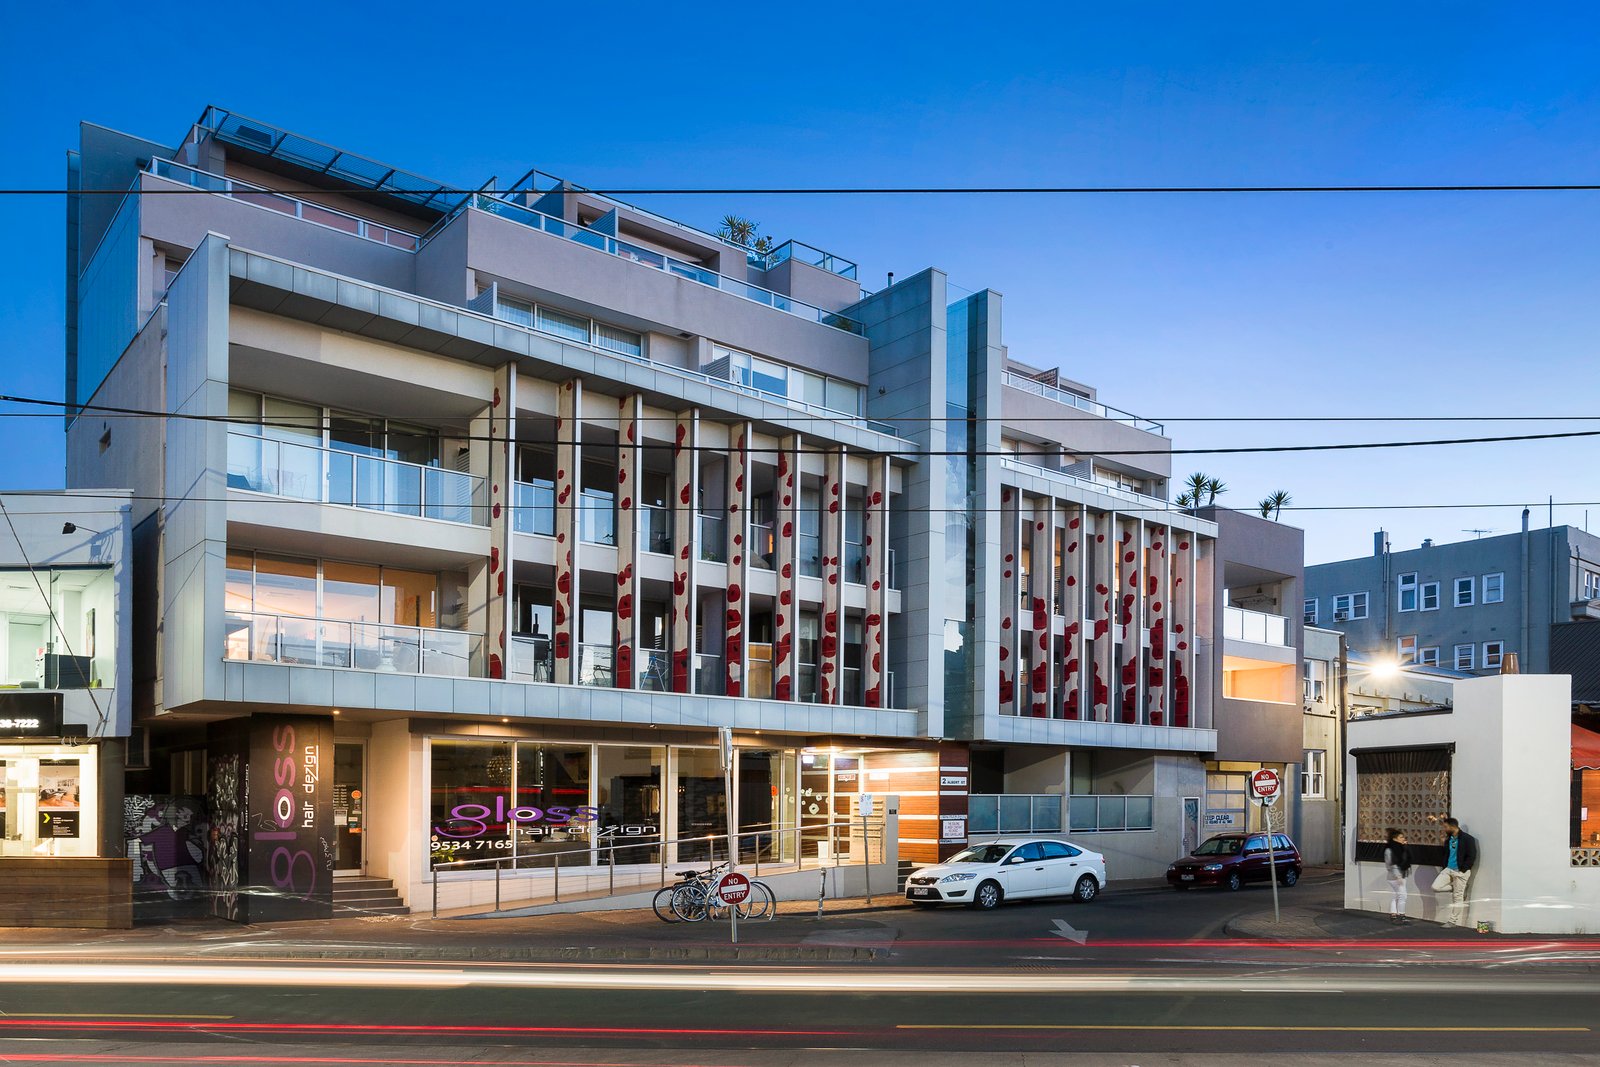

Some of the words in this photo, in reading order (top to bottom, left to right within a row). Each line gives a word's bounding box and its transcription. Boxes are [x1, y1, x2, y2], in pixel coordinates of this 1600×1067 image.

[302, 745, 319, 793] dezign
[1257, 785, 1276, 793] ENTRY
[254, 724, 316, 901] gloss
[301, 801, 313, 828] hair
[434, 795, 601, 838] gloss
[506, 822, 560, 835] hair
[568, 823, 661, 838] dezign
[430, 840, 472, 851] 9534
[476, 839, 513, 849] 7165
[728, 877, 739, 885] NO
[723, 891, 746, 901] ENTRY
